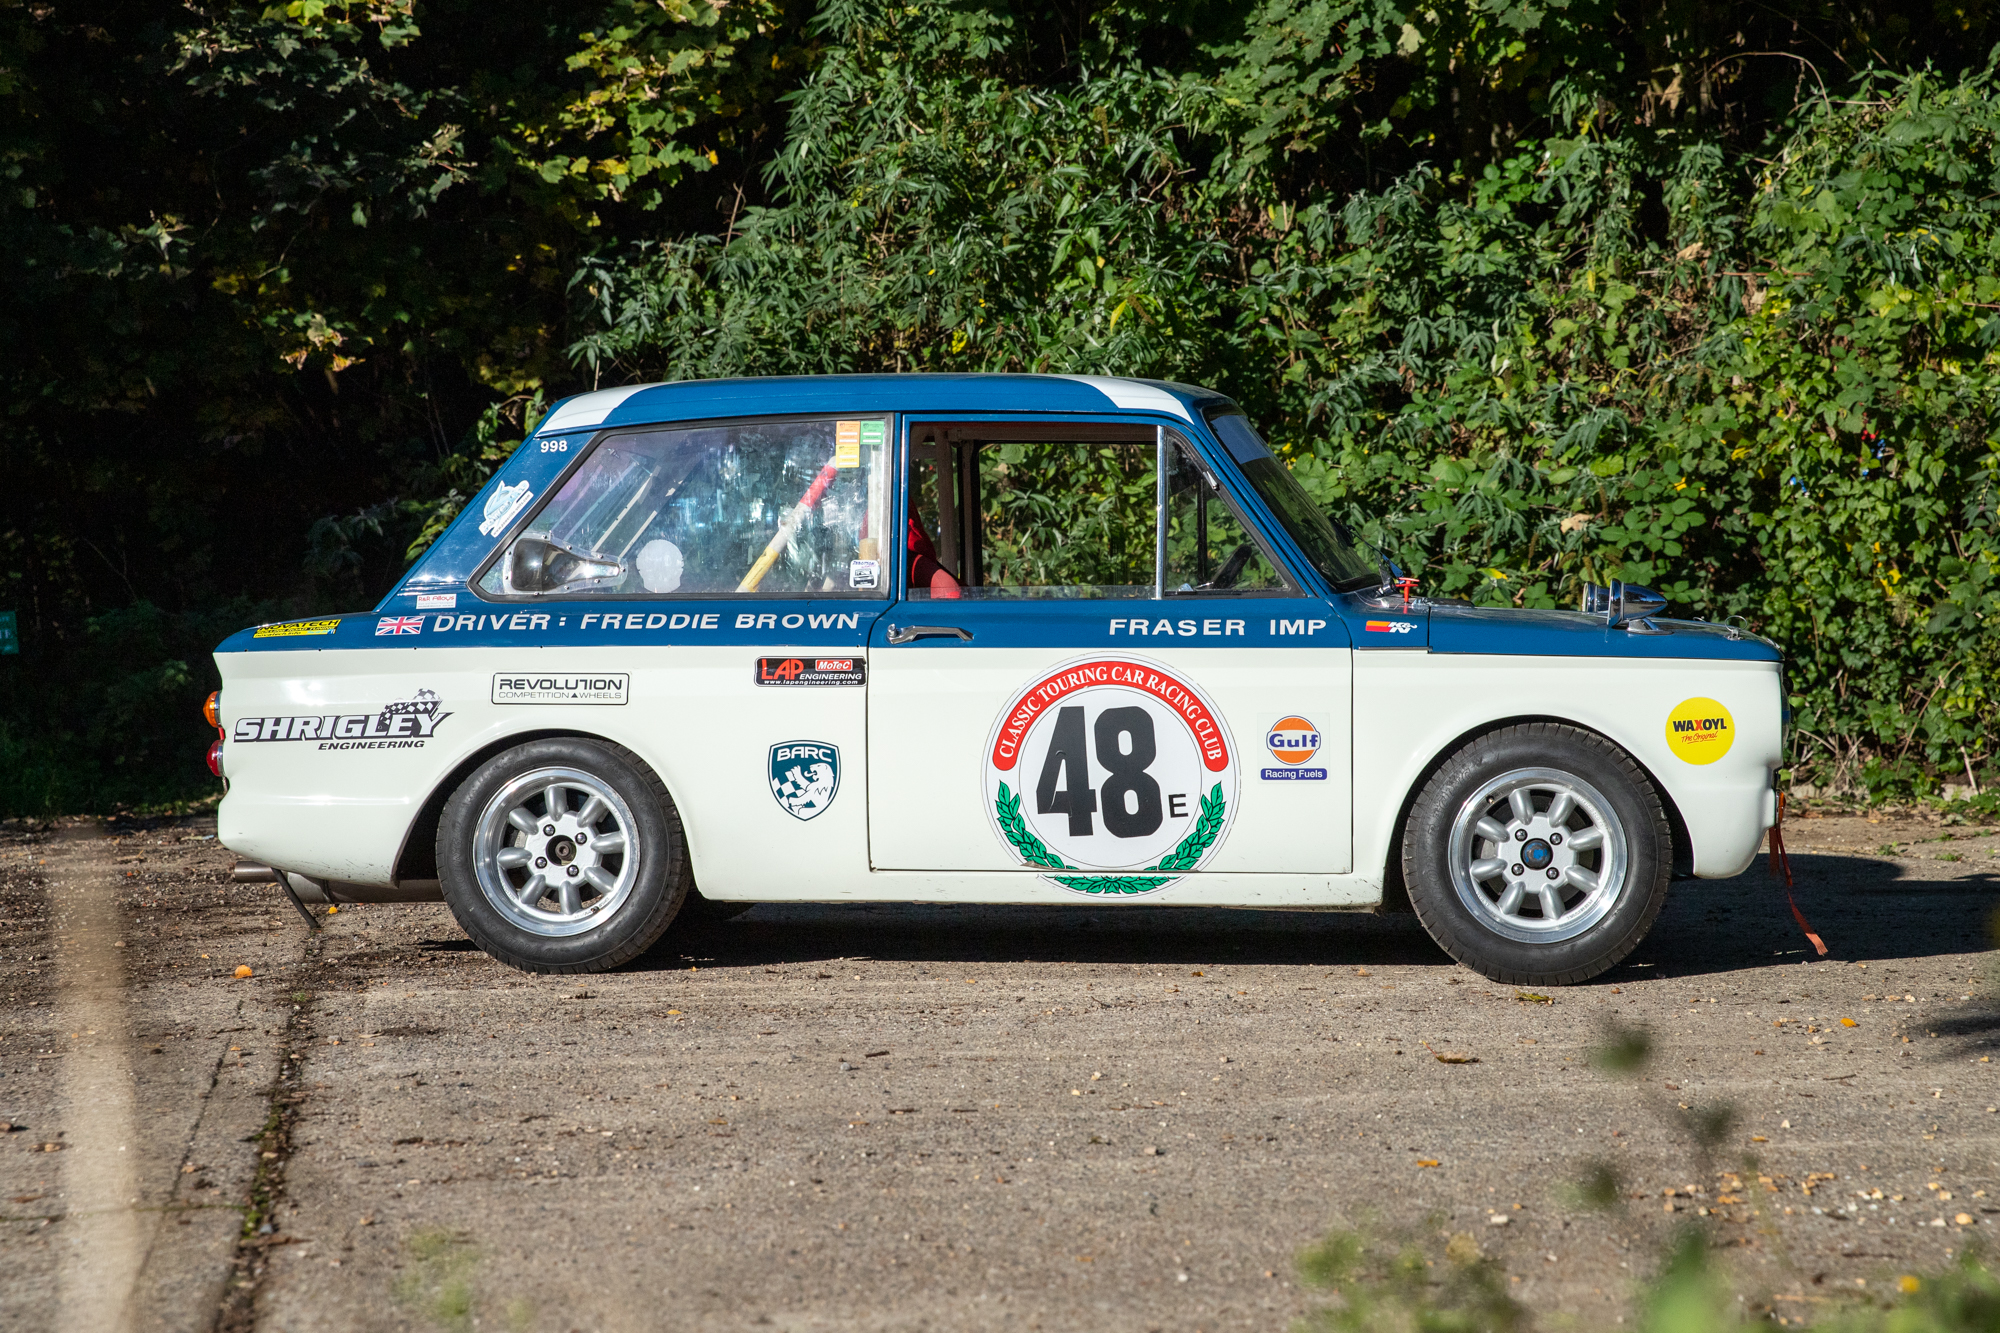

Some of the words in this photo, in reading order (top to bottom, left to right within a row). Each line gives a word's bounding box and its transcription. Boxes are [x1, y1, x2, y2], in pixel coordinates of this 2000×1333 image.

[540, 440, 568, 453] 998
[580, 613, 721, 630] FREDDIE
[735, 613, 859, 629] BROWN
[1109, 618, 1246, 636] FRASER
[1270, 618, 1327, 636] IMP
[761, 658, 804, 680] LAP
[818, 660, 850, 669] MoTeC
[499, 678, 622, 691] REVOLUTION
[498, 691, 569, 699] COMPETITION
[579, 691, 622, 699] WHEELS
[999, 697, 1042, 758] CLASSIC
[1036, 666, 1108, 702] TOURING
[1111, 666, 1145, 684] CAR
[1145, 674, 1203, 721] RACING
[1195, 715, 1223, 760] CLUB
[234, 712, 454, 743] SHRIGLEY
[1672, 718, 1727, 732] WAXOYL
[1269, 733, 1318, 748] Gulf
[1681, 733, 1692, 743] The
[1693, 730, 1719, 742] Original
[318, 740, 425, 751] ENGINEERING
[777, 746, 832, 762] BARC
[1036, 705, 1163, 838] 48
[1168, 793, 1189, 818] E
[1265, 769, 1296, 780] Racing
[1299, 769, 1323, 778] Fuels
